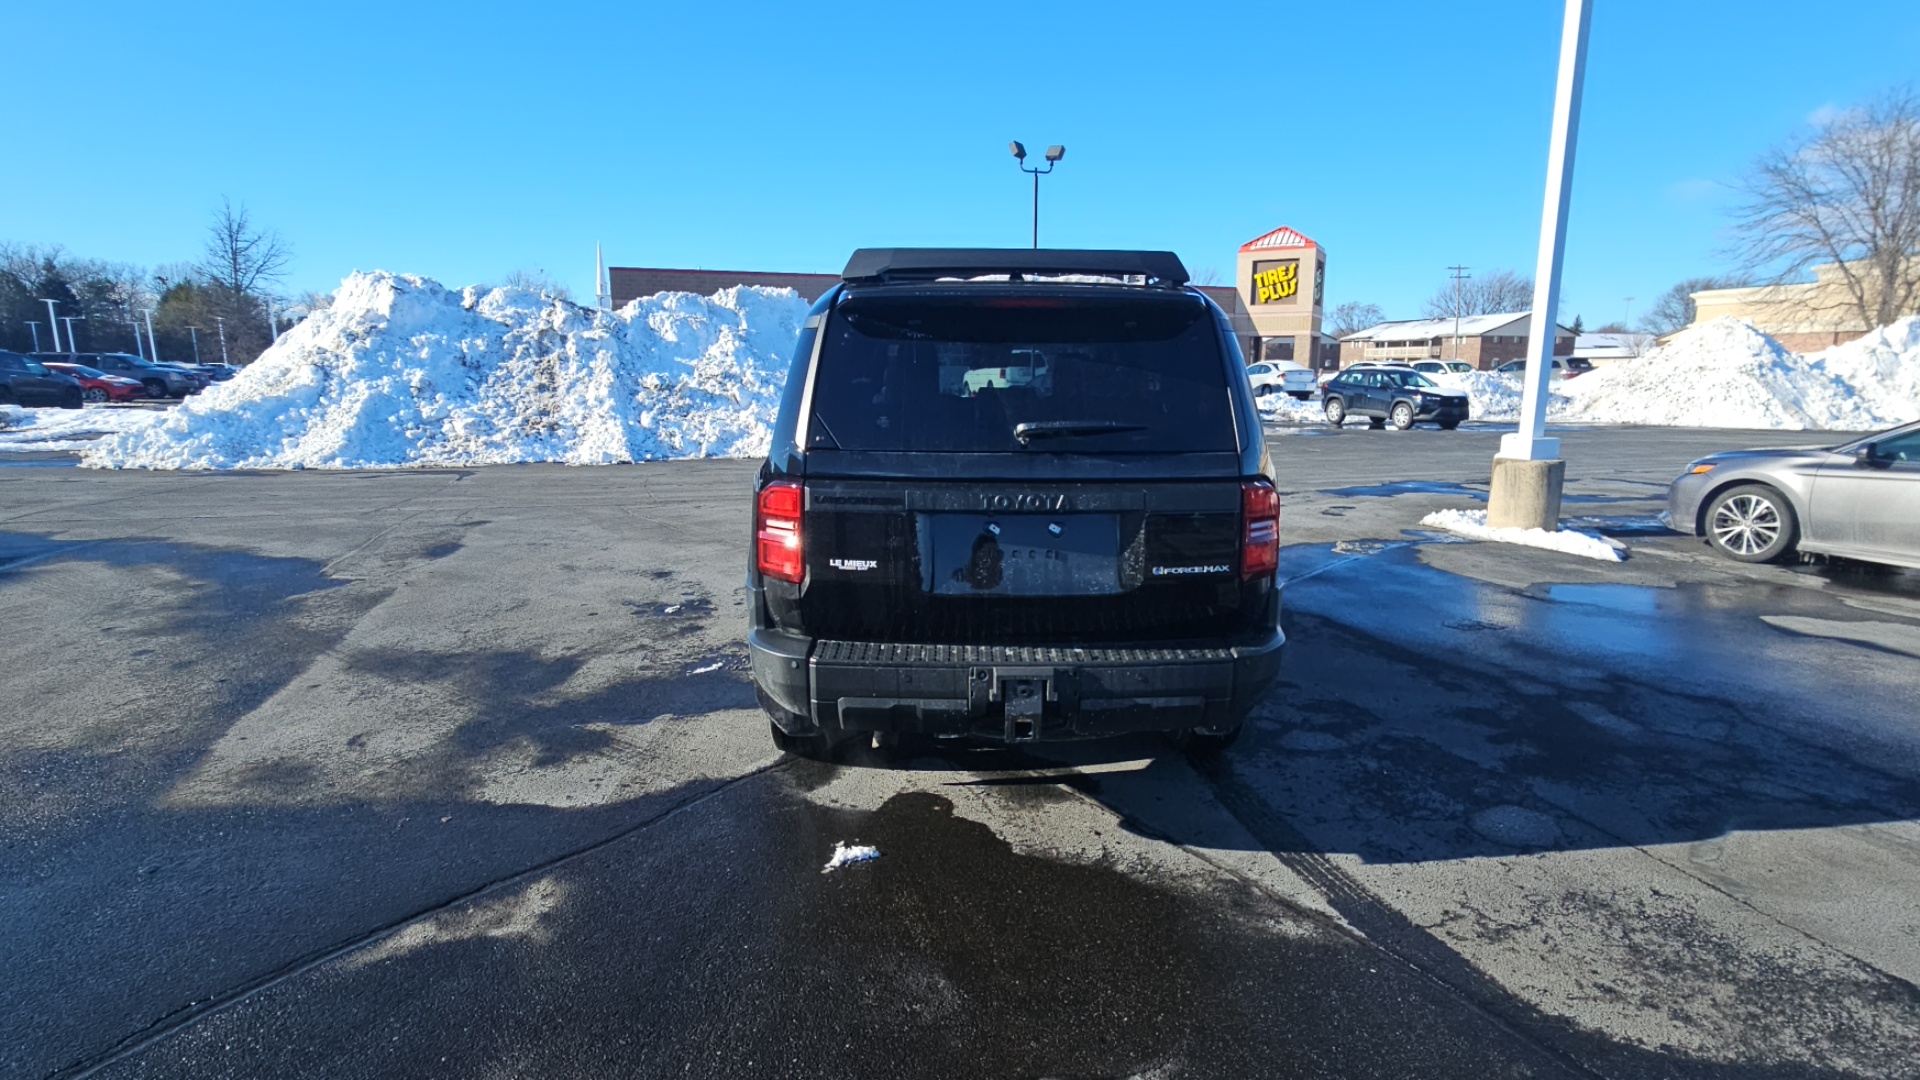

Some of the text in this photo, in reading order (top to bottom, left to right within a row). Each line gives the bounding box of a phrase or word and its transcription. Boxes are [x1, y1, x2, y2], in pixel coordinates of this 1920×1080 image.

[1254, 263, 1297, 288] TIRES
[1258, 278, 1298, 303] PLUS
[979, 494, 1069, 510] TOYOTA
[829, 559, 878, 568] LE MIEUX
